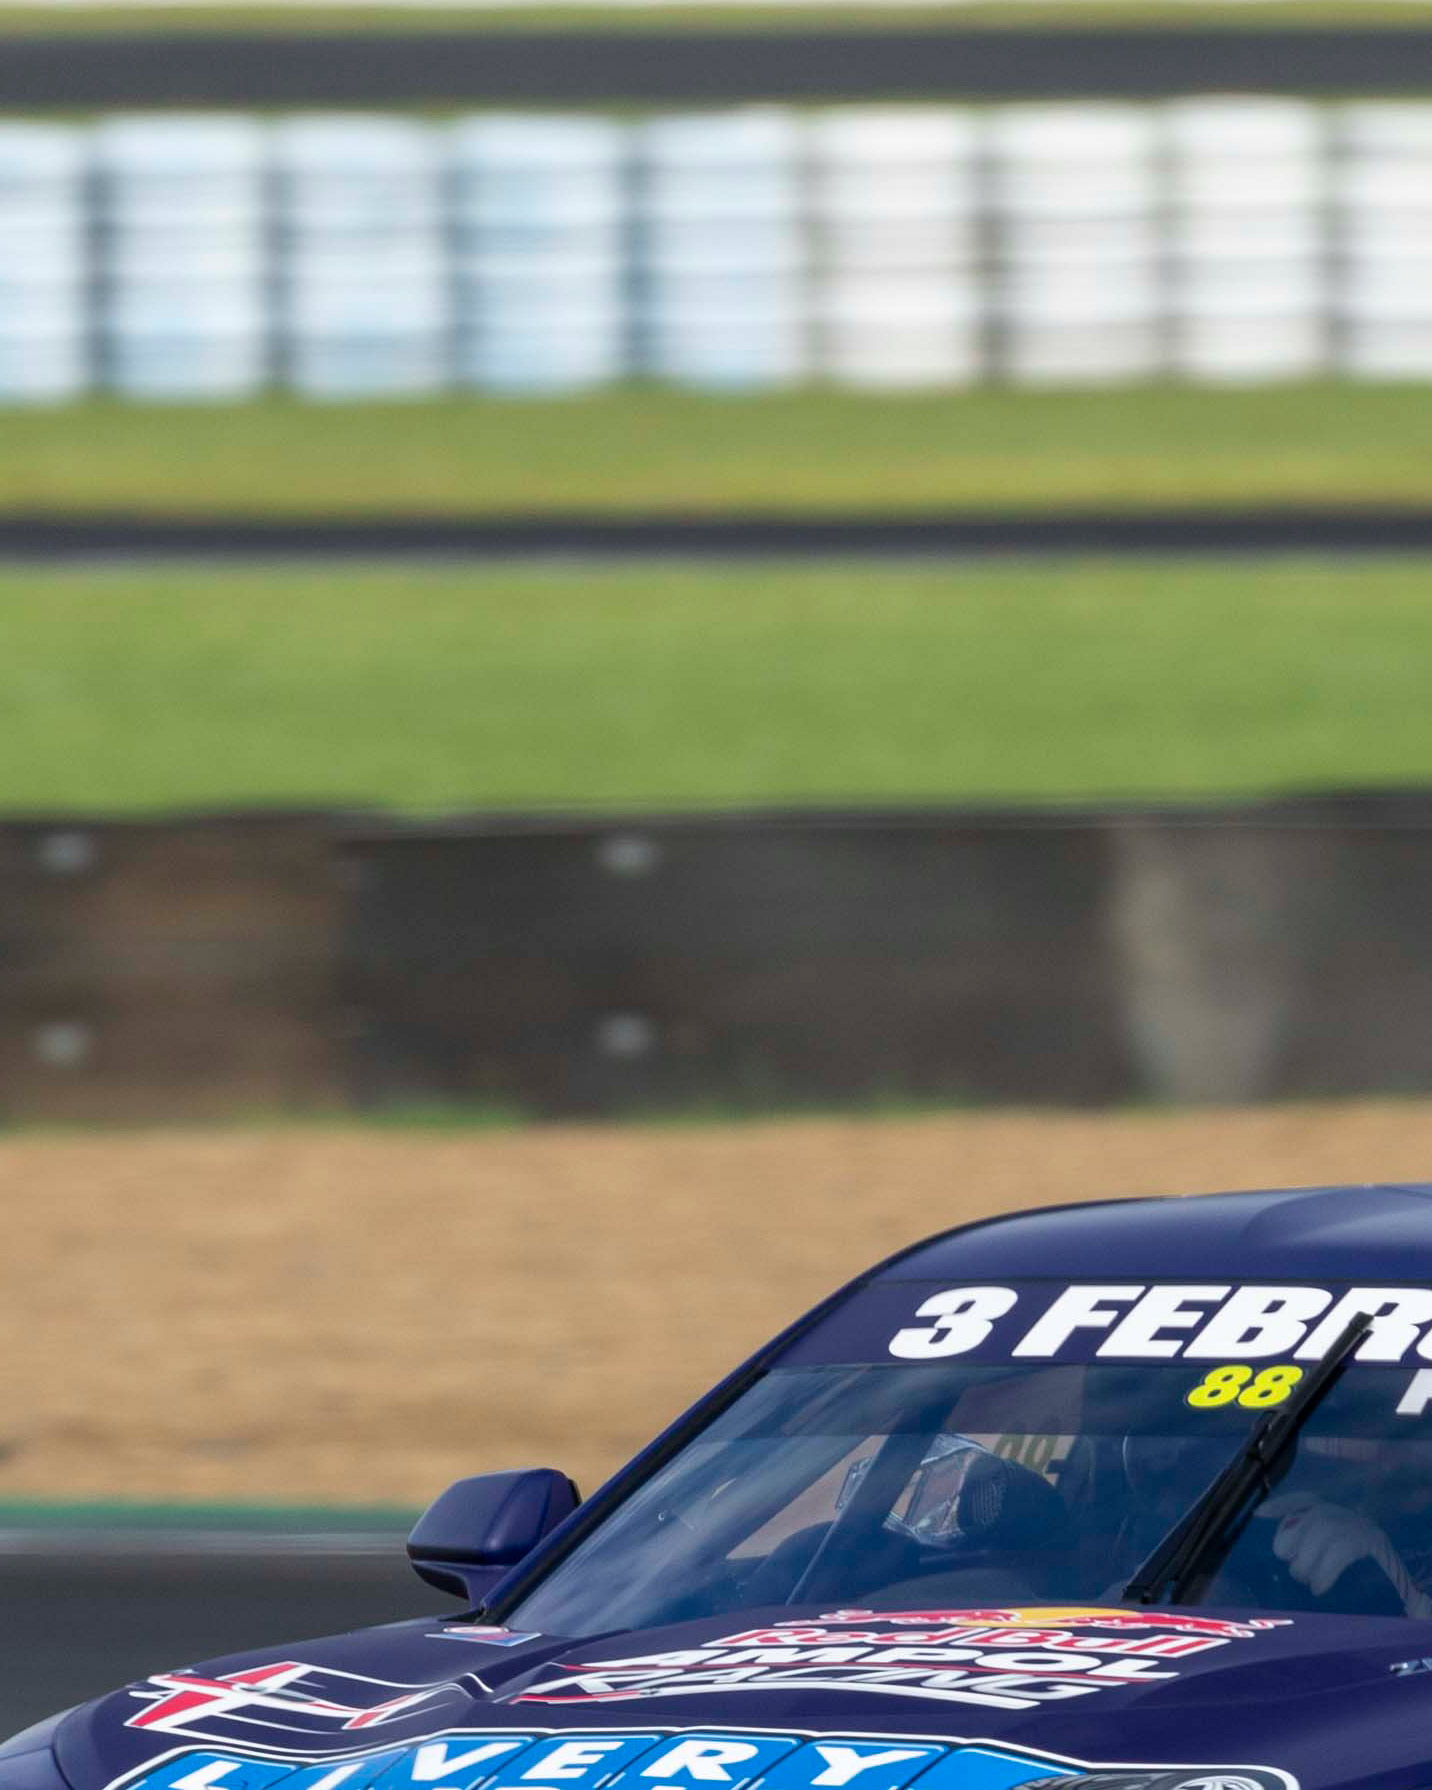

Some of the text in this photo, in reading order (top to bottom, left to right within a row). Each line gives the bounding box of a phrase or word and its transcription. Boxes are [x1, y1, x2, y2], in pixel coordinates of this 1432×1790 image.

[888, 1285, 1018, 1360] 3
[1186, 1364, 1304, 1408] 88
[582, 1647, 1180, 1679] AMPOL
[518, 1666, 1128, 1700] RACING
